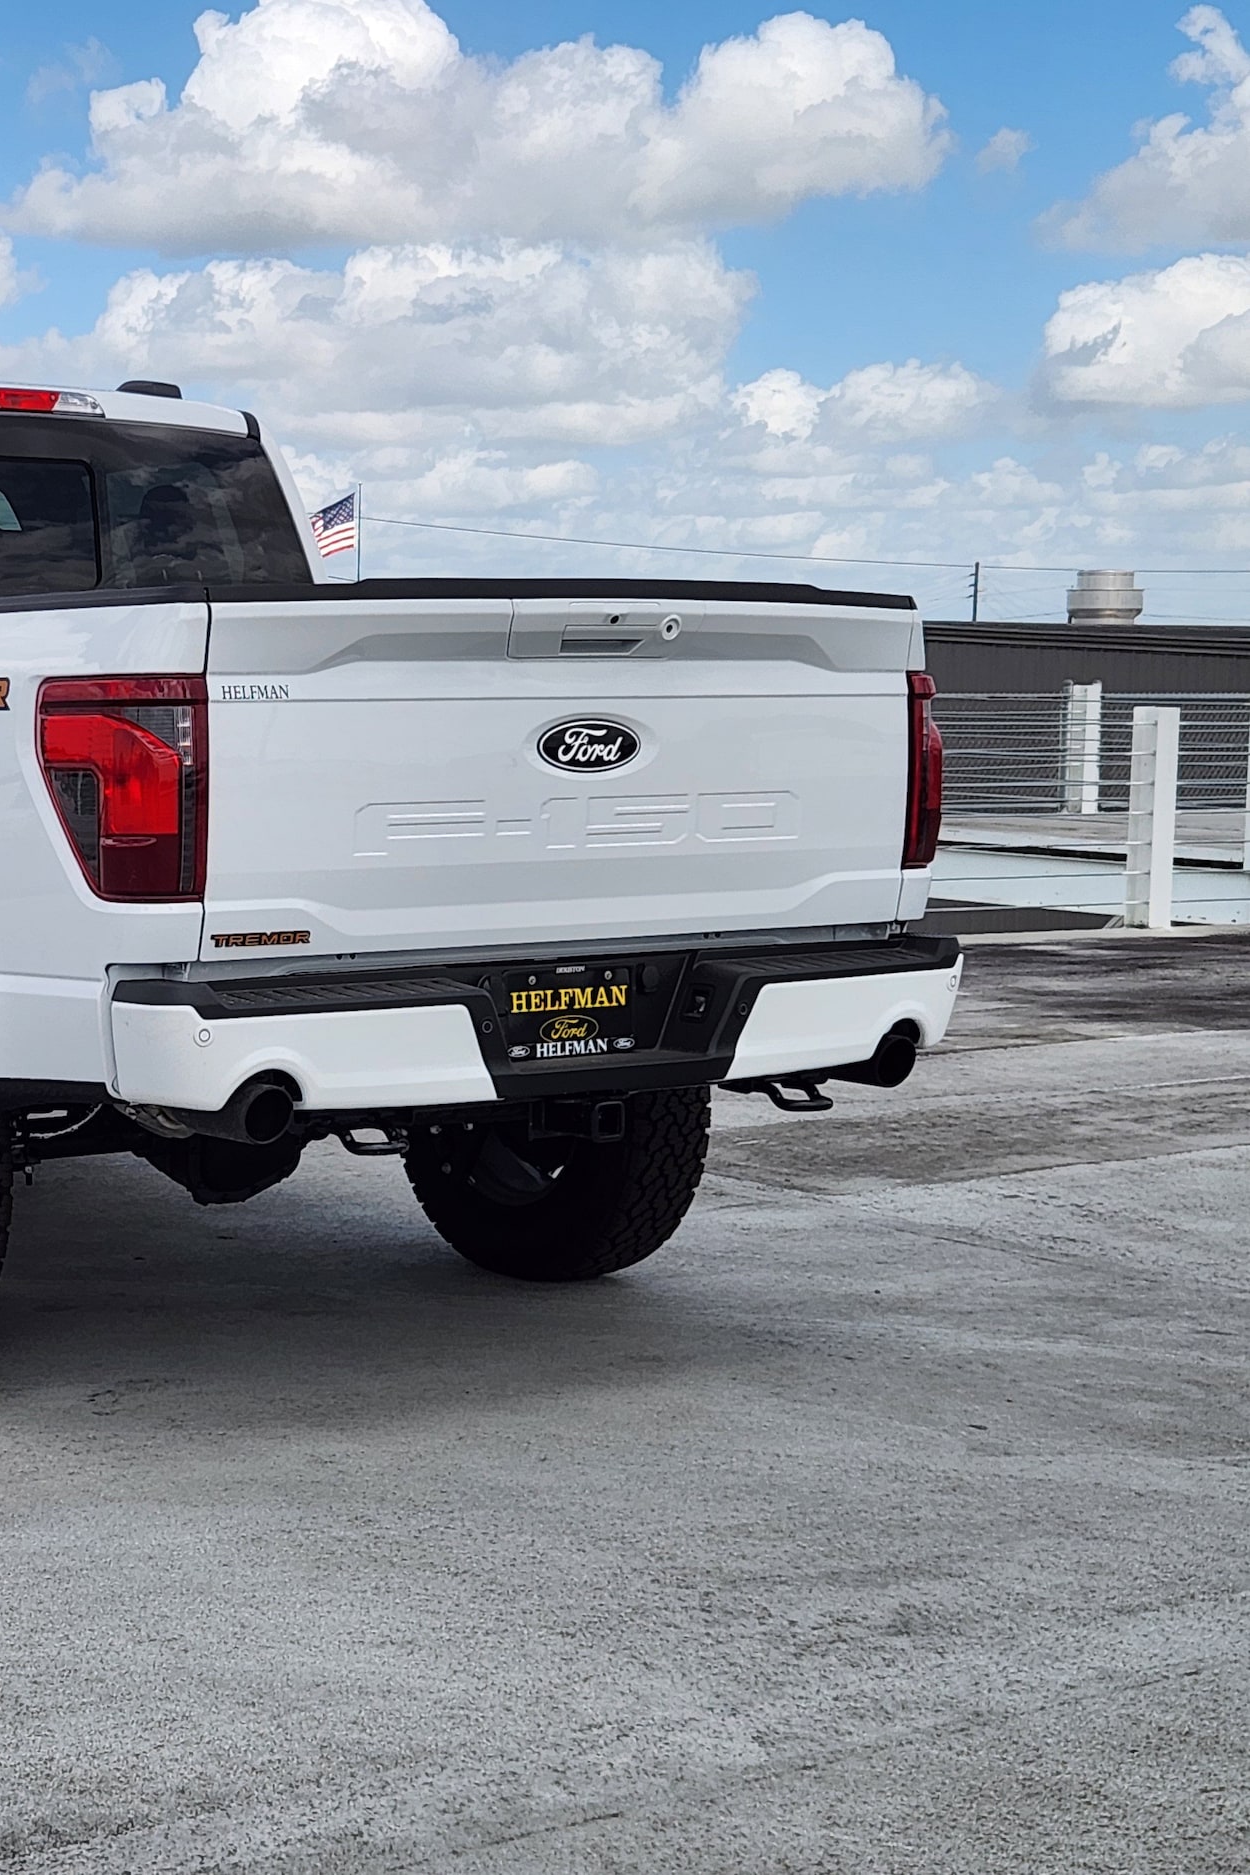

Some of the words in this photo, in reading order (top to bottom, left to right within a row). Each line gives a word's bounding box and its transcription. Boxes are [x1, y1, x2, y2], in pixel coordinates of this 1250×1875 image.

[221, 684, 290, 700] HELFMAN
[557, 727, 622, 763] Ford
[353, 790, 800, 857] F-150
[210, 930, 310, 948] TREMOR
[510, 985, 628, 1013] HELFMAN
[550, 1019, 589, 1040] Ford
[536, 1038, 609, 1058] HELFMAN
